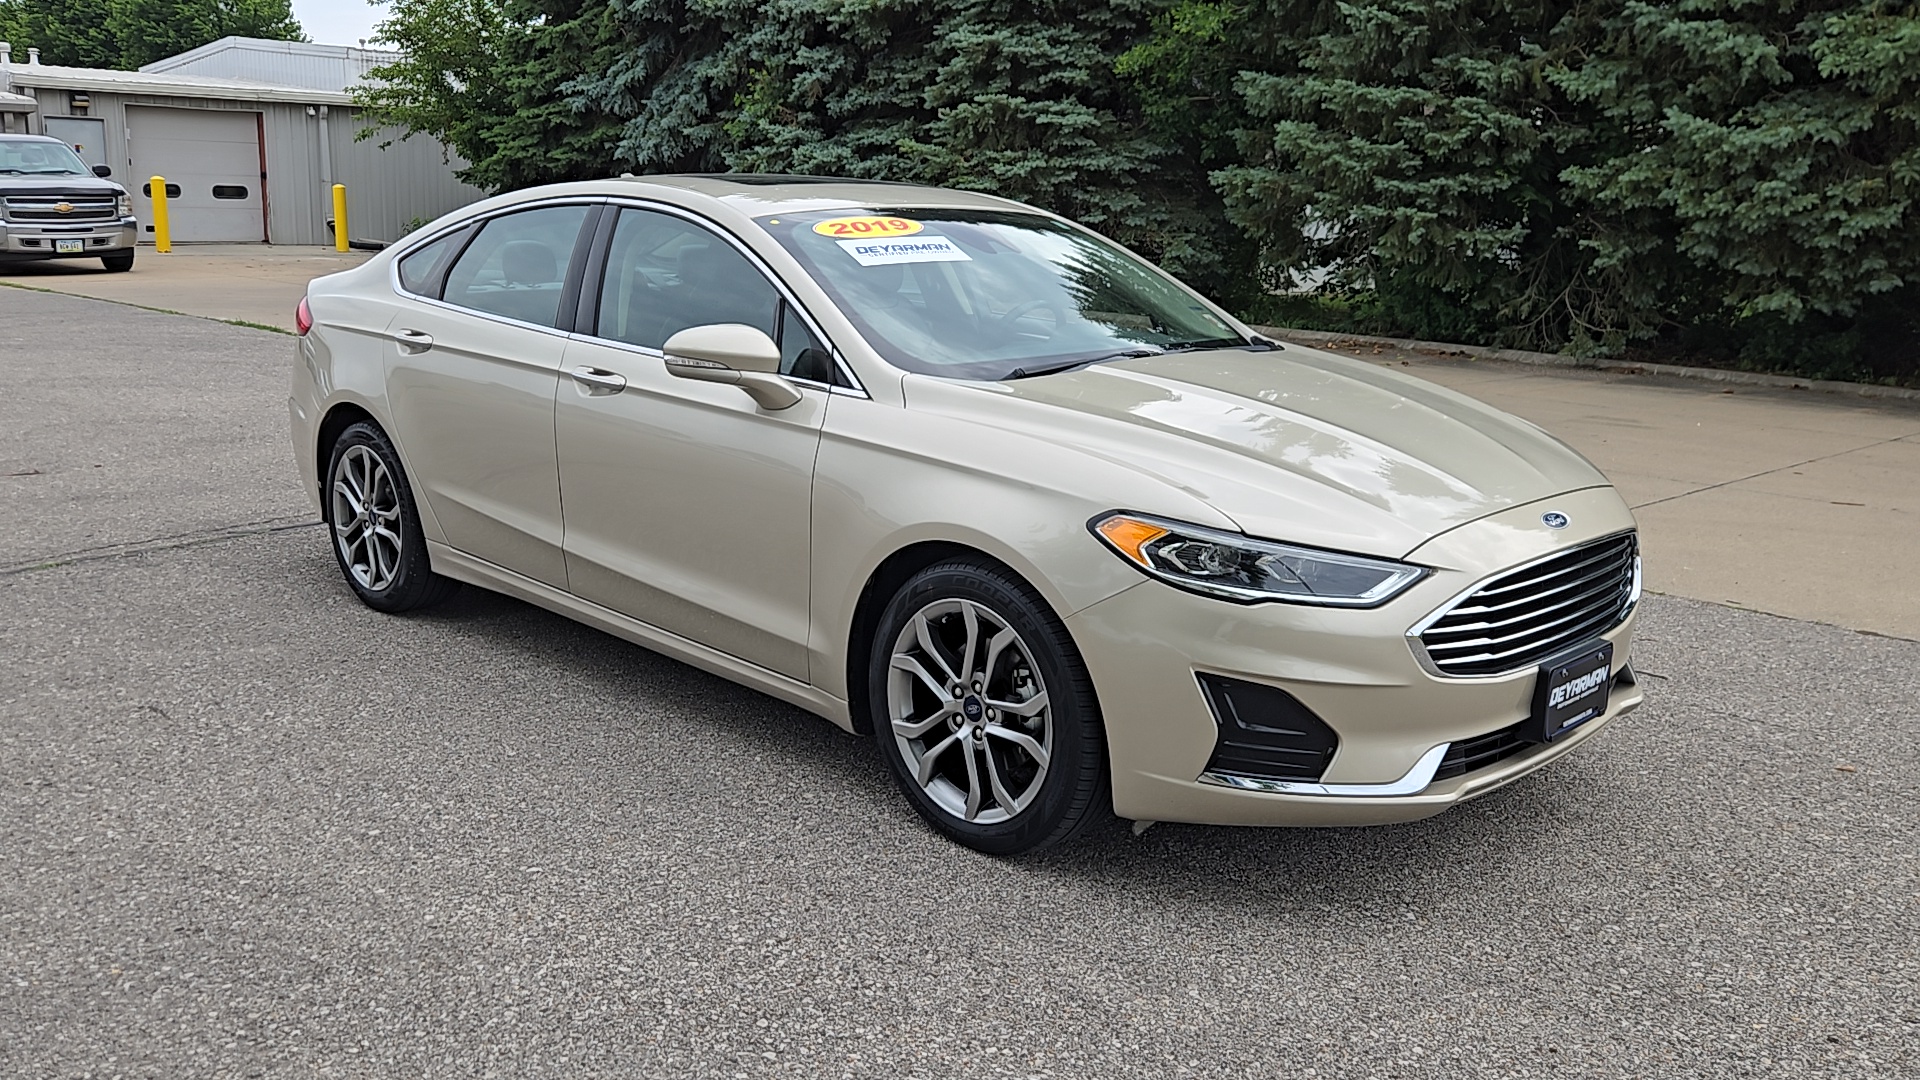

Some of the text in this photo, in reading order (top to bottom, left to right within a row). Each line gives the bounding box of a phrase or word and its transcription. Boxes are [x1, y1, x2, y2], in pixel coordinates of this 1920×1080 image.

[829, 219, 911, 235] 2019
[855, 243, 951, 255] DEYARMAN
[1548, 664, 1610, 708] DEYARMAN
